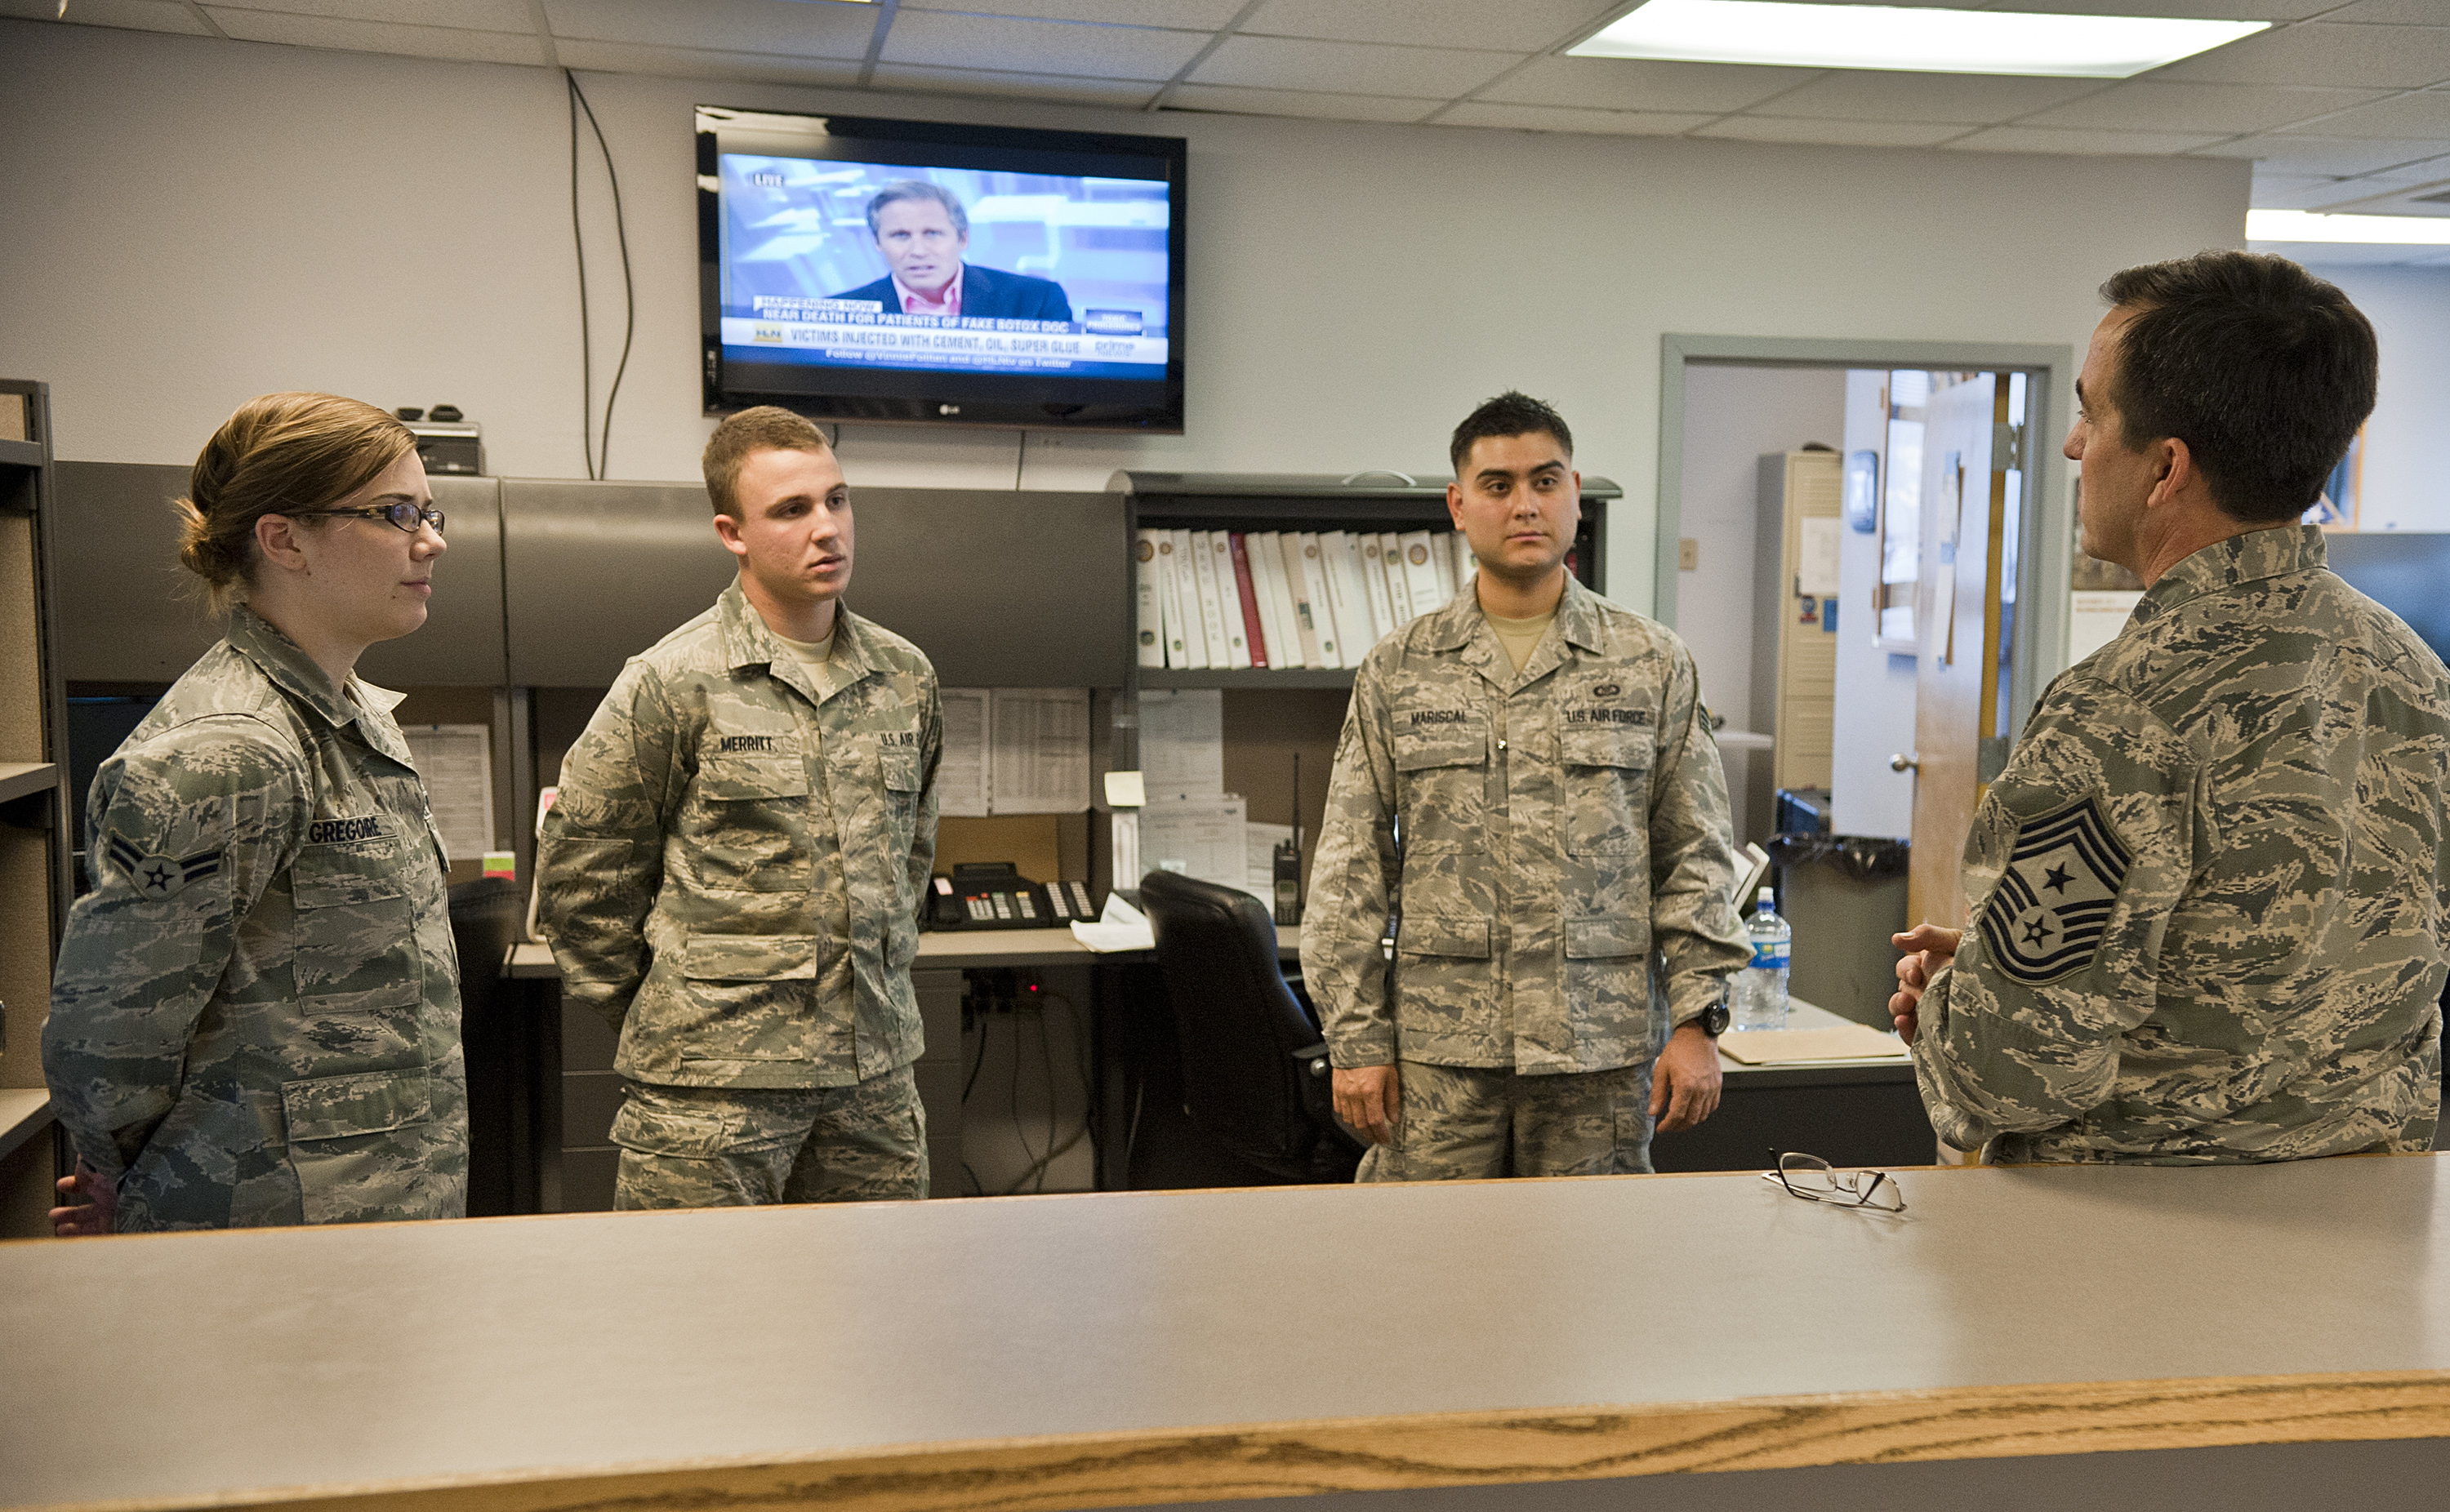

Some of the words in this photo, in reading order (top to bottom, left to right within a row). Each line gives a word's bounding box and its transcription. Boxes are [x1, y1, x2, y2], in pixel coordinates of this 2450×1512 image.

[763, 309, 800, 321] NEAR
[801, 310, 846, 323] DEATH
[848, 312, 875, 324] FOR
[877, 313, 940, 327] PATIENTS
[942, 316, 960, 328] OF
[962, 316, 995, 330] FAKE
[996, 318, 1040, 332] BOTOX
[1041, 320, 1069, 333] DOC
[791, 327, 838, 343] VICTIMS
[843, 331, 896, 345] INJECTED
[900, 333, 929, 347] WITH
[1011, 338, 1049, 353] SUPER
[1051, 340, 1080, 354] GLUE
[1411, 709, 1468, 726] MARISCAL
[1590, 709, 1610, 723] AIR
[1612, 709, 1646, 726] FORCE
[720, 735, 772, 752] MERRITT
[900, 732, 914, 746] AIR
[309, 816, 382, 843] GREGOIRE
